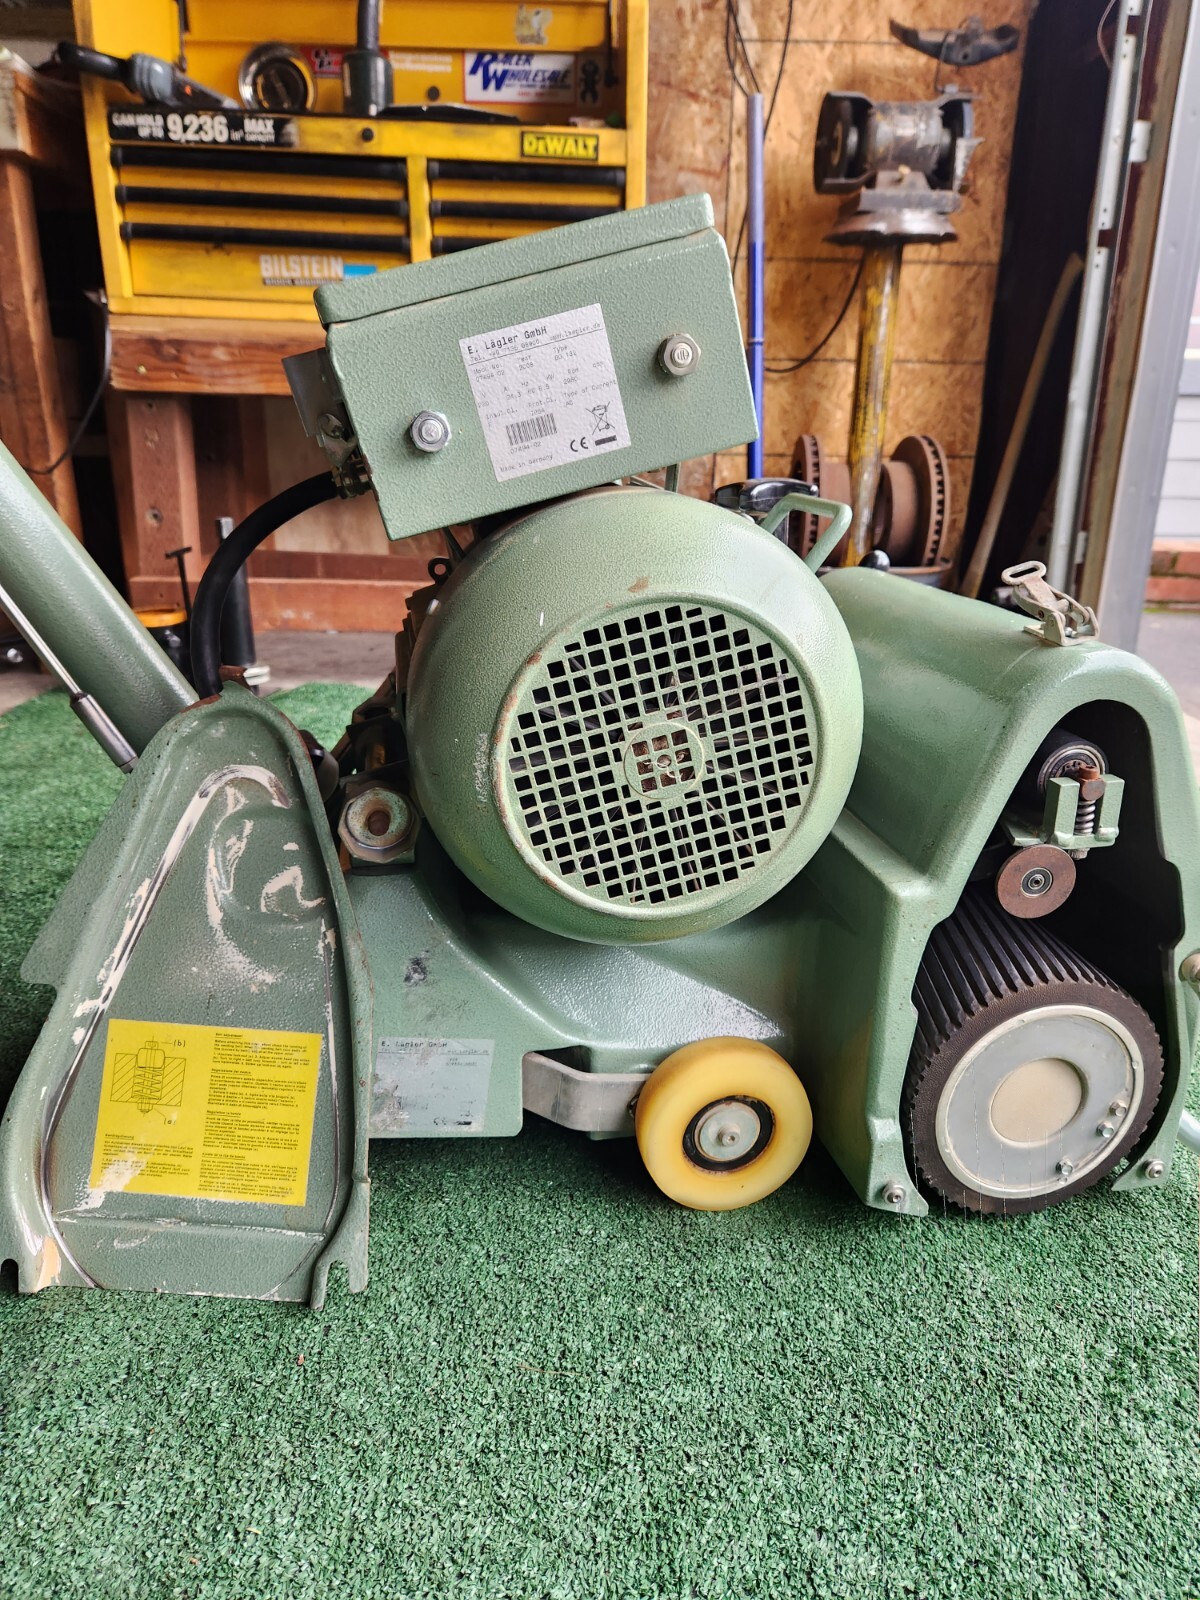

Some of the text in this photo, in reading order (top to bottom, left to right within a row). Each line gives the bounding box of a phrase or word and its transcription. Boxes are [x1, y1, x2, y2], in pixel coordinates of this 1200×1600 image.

[167, 112, 229, 143] 9,236
[244, 118, 276, 134] MAX
[260, 254, 344, 279] BILSTEIN
[467, 326, 548, 355] E. Lägler GmbH
